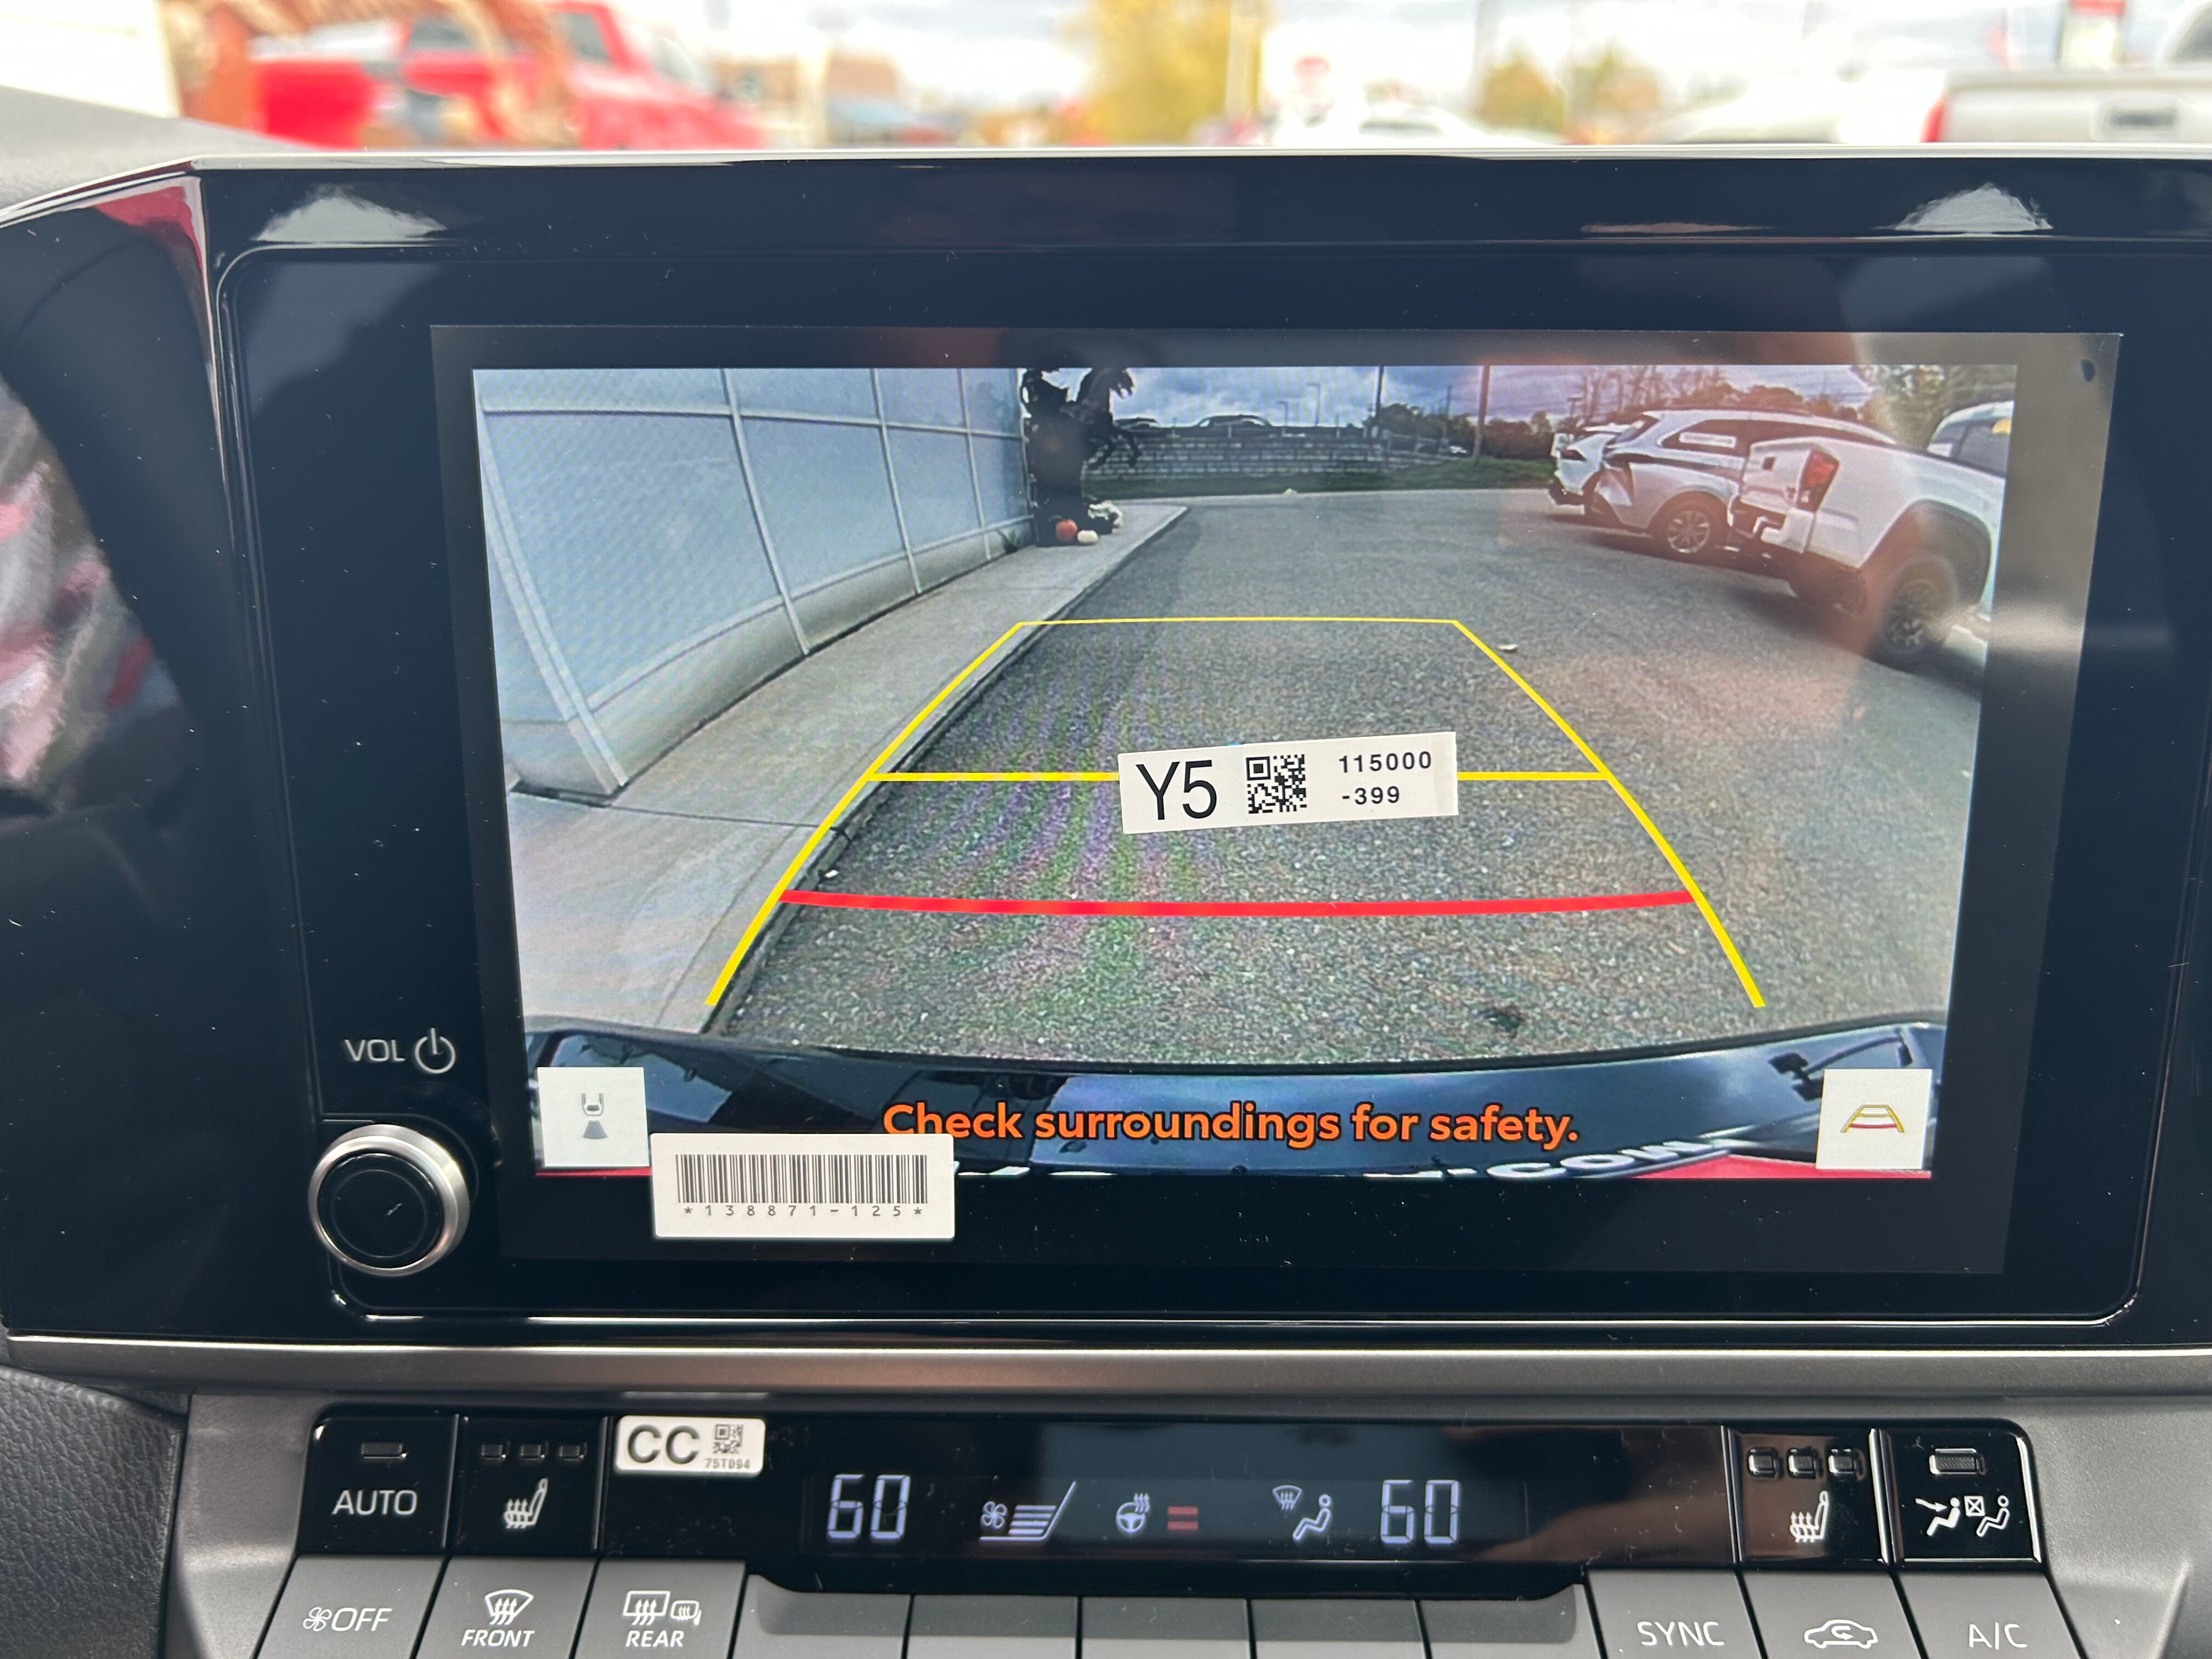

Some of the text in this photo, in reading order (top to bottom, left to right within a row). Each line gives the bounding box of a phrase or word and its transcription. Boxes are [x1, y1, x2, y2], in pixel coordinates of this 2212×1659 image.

[1339, 751, 1432, 774] 115000
[1136, 759, 1217, 821] Y5
[1342, 786, 1401, 805] -399
[344, 1039, 406, 1062] VOL
[882, 1101, 1578, 1150] Check surroundings for safety.
[628, 1425, 699, 1464] CC
[332, 1489, 418, 1516] AUTO
[827, 1474, 912, 1540] 60
[1380, 1479, 1461, 1545] 60
[331, 1607, 393, 1633] OFF
[461, 1629, 535, 1647] FRONT
[625, 1630, 685, 1648] REAR
[1637, 1621, 1725, 1647] SYNC
[1968, 1622, 2028, 1648] A/C
